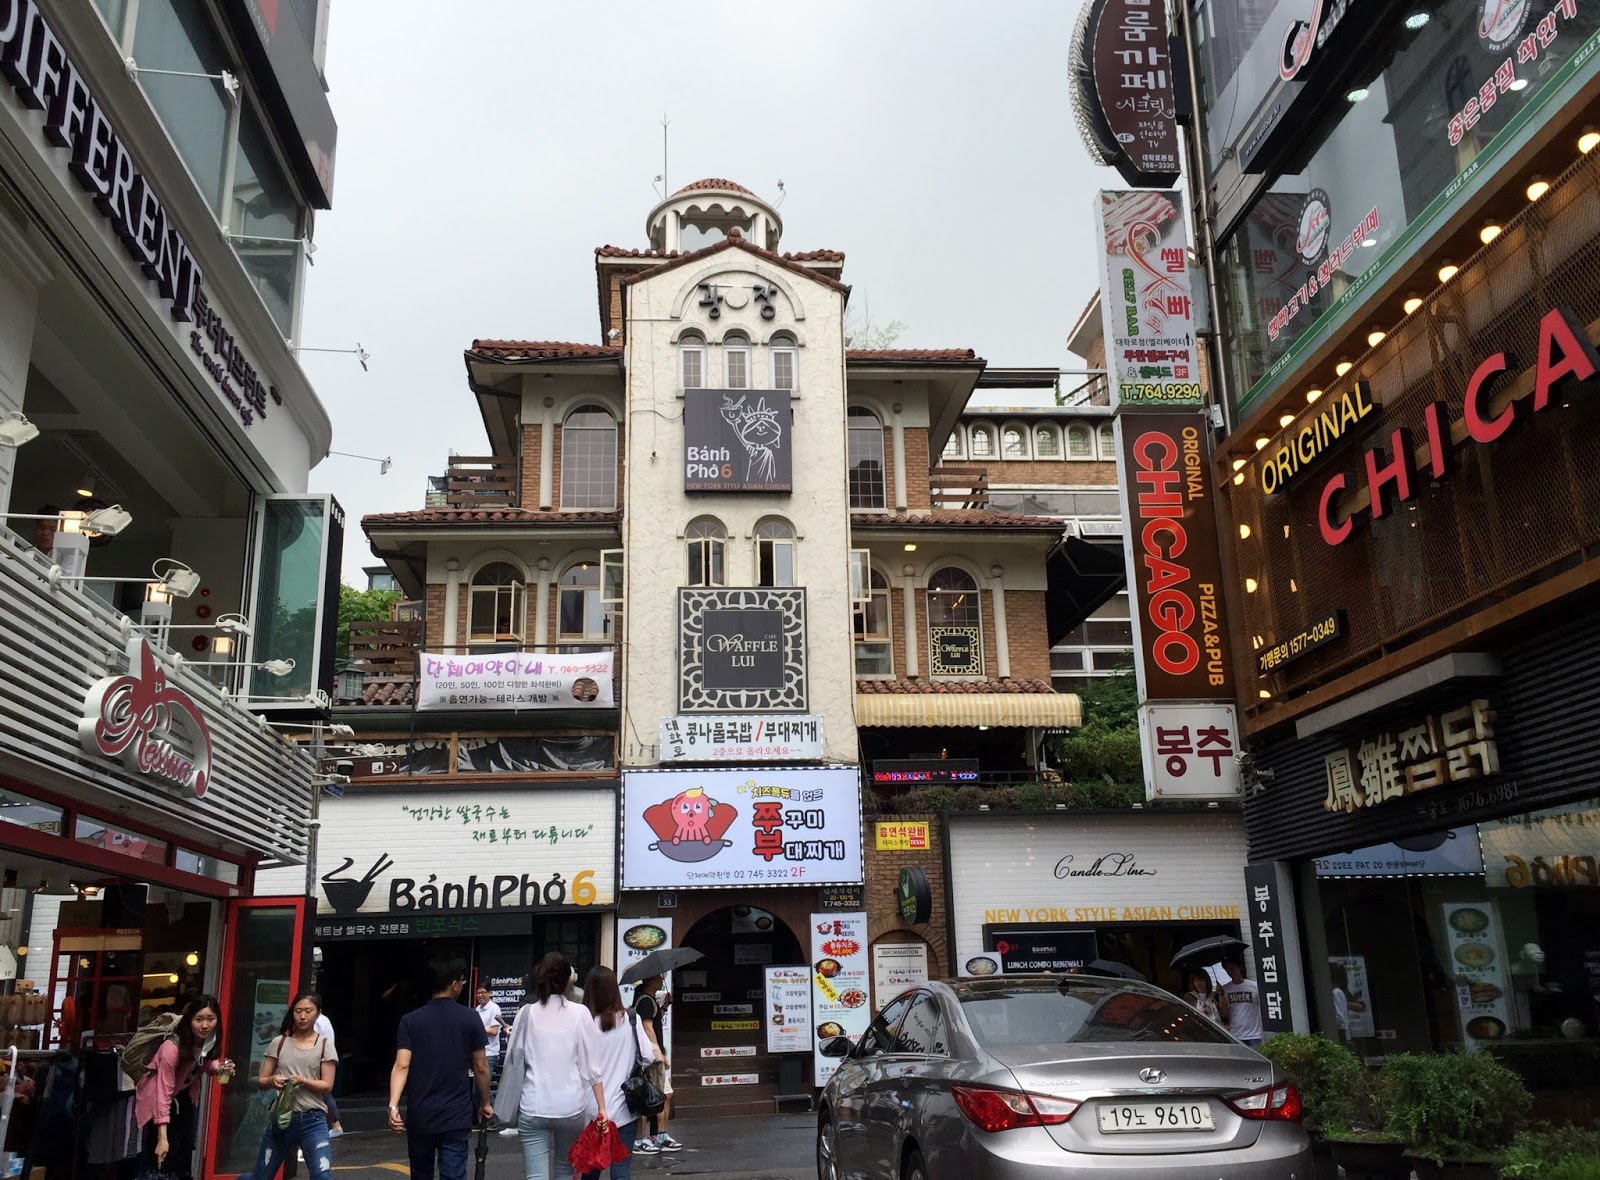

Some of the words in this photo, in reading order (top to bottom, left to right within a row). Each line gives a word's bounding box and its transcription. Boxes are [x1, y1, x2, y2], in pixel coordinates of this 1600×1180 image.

[1114, 11, 1167, 89] 룸카페
[1115, 97, 1175, 118] 시크릿
[1147, 140, 1159, 148] TV
[1445, 175, 1463, 199] SELF
[1461, 161, 1478, 184] BAR
[1122, 268, 1137, 304] SELF
[1125, 306, 1140, 337] BAR
[1174, 365, 1189, 379] 3F
[1120, 383, 1201, 401] T.764.9294
[1261, 381, 1374, 495] ORIGINAL
[1181, 426, 1205, 502] ORIGINAL
[687, 482, 701, 490] NEW
[703, 482, 722, 490] YORK
[764, 482, 790, 490] CUISINE
[1133, 430, 1200, 677] CHICAGO
[706, 633, 778, 653] WAFFLE
[1198, 583, 1225, 687] PIZZA&PUB
[1259, 641, 1290, 671] 가맹문의
[1289, 616, 1337, 654] 1577-0349
[731, 655, 755, 667] LUI
[483, 681, 505, 689] 100인
[507, 681, 528, 689] 다양한
[529, 694, 547, 703] 개방
[1156, 725, 1233, 778] 봉추
[880, 826, 925, 837] 흡연석완비
[752, 829, 845, 862] 부대찌개
[734, 870, 744, 878] 02
[748, 870, 764, 878] 745
[767, 869, 788, 878] 3322
[790, 866, 806, 877] 2F
[1054, 854, 1103, 879] Candle
[1104, 852, 1157, 876] Line
[985, 909, 1021, 923] NEW
[1024, 908, 1069, 923] YORK
[1075, 907, 1117, 922] STYLE
[1123, 906, 1173, 921] ASIAN
[1176, 905, 1240, 920] CUISINE
[346, 924, 376, 936] 쌀국수
[379, 923, 409, 934] 전문점
[1007, 961, 1027, 969] LUNCH
[1053, 960, 1083, 968] RENEWAL!
[1110, 1105, 1147, 1128] 19노
[1154, 1105, 1202, 1126] 9610
